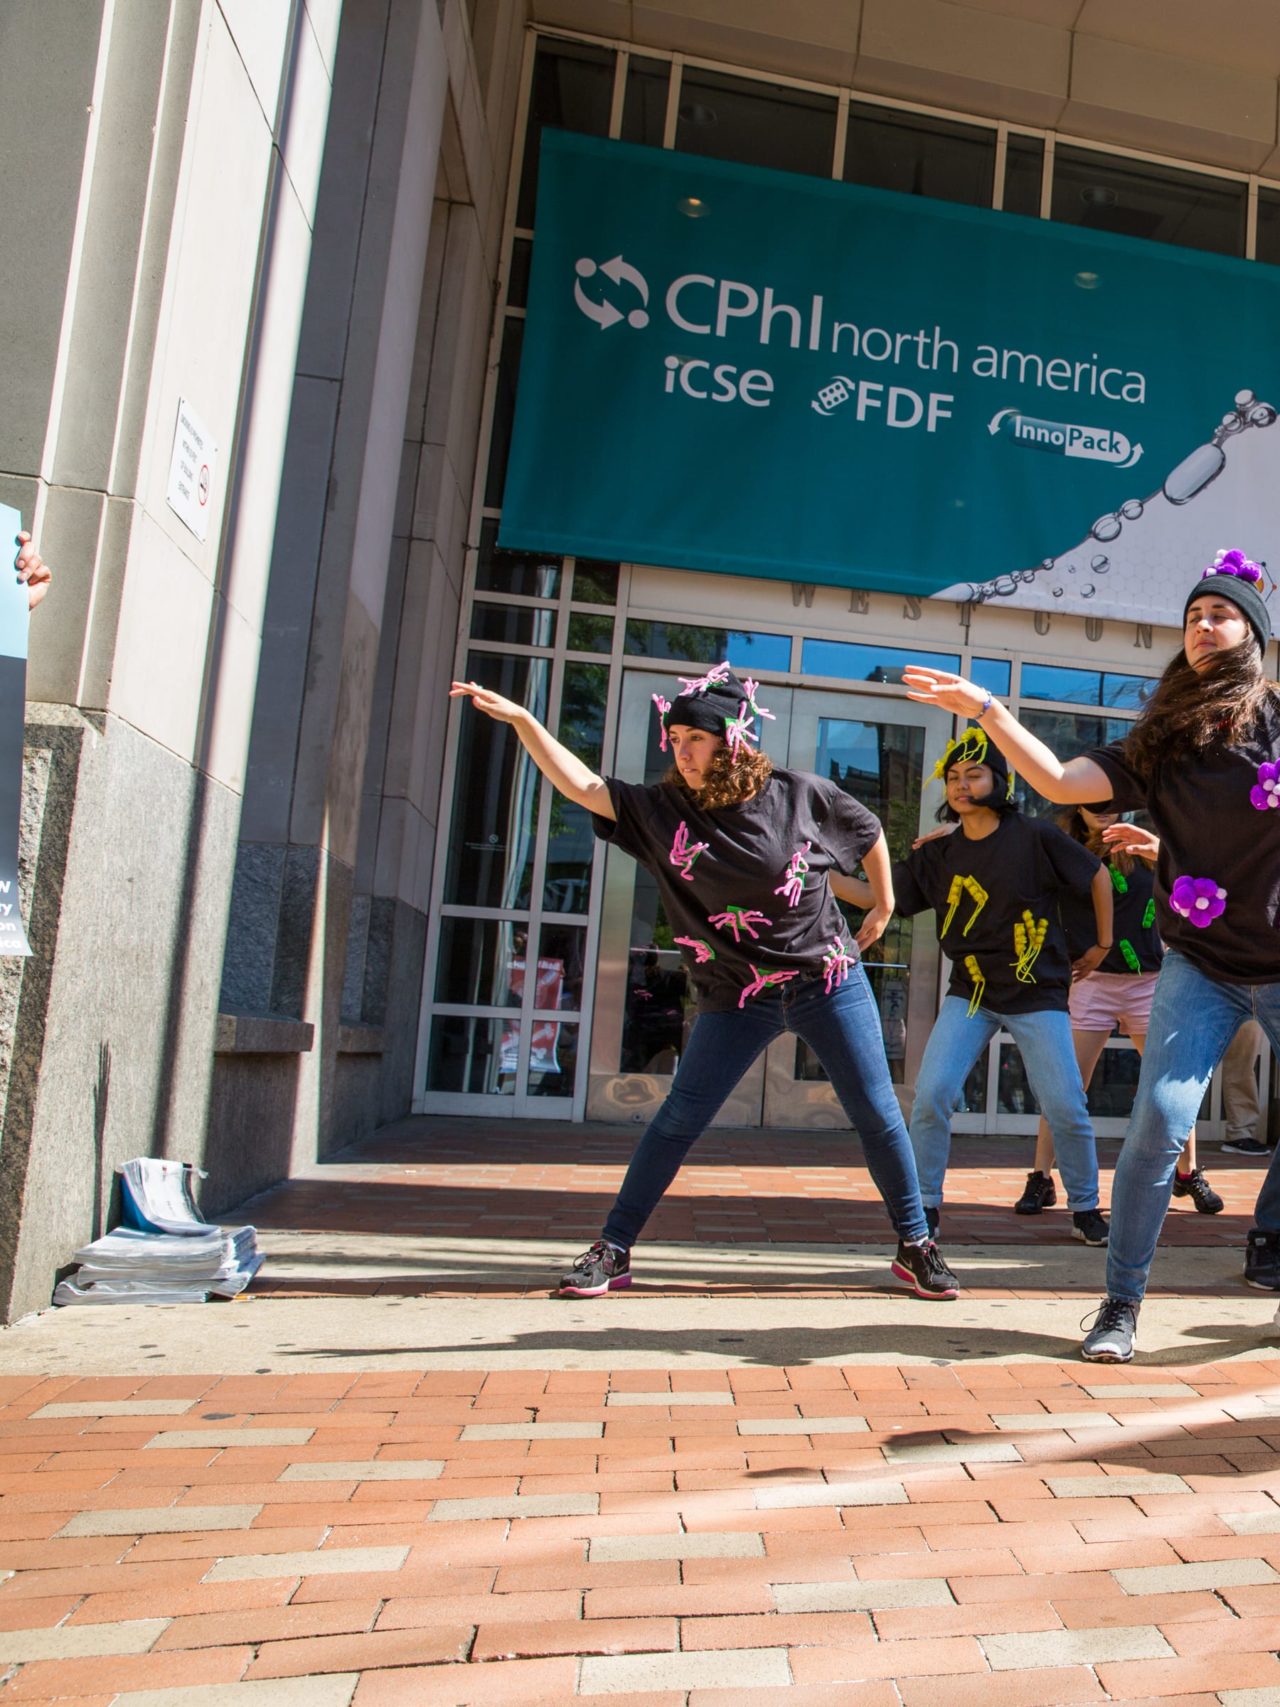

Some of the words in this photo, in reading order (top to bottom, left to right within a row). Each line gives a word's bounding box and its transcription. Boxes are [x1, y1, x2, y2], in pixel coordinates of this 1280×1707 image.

[832, 318, 959, 374] north
[971, 345, 1146, 405] america
[855, 380, 955, 433] FDF
[1014, 415, 1122, 455] InnoPack
[791, 580, 976, 628] WEST
